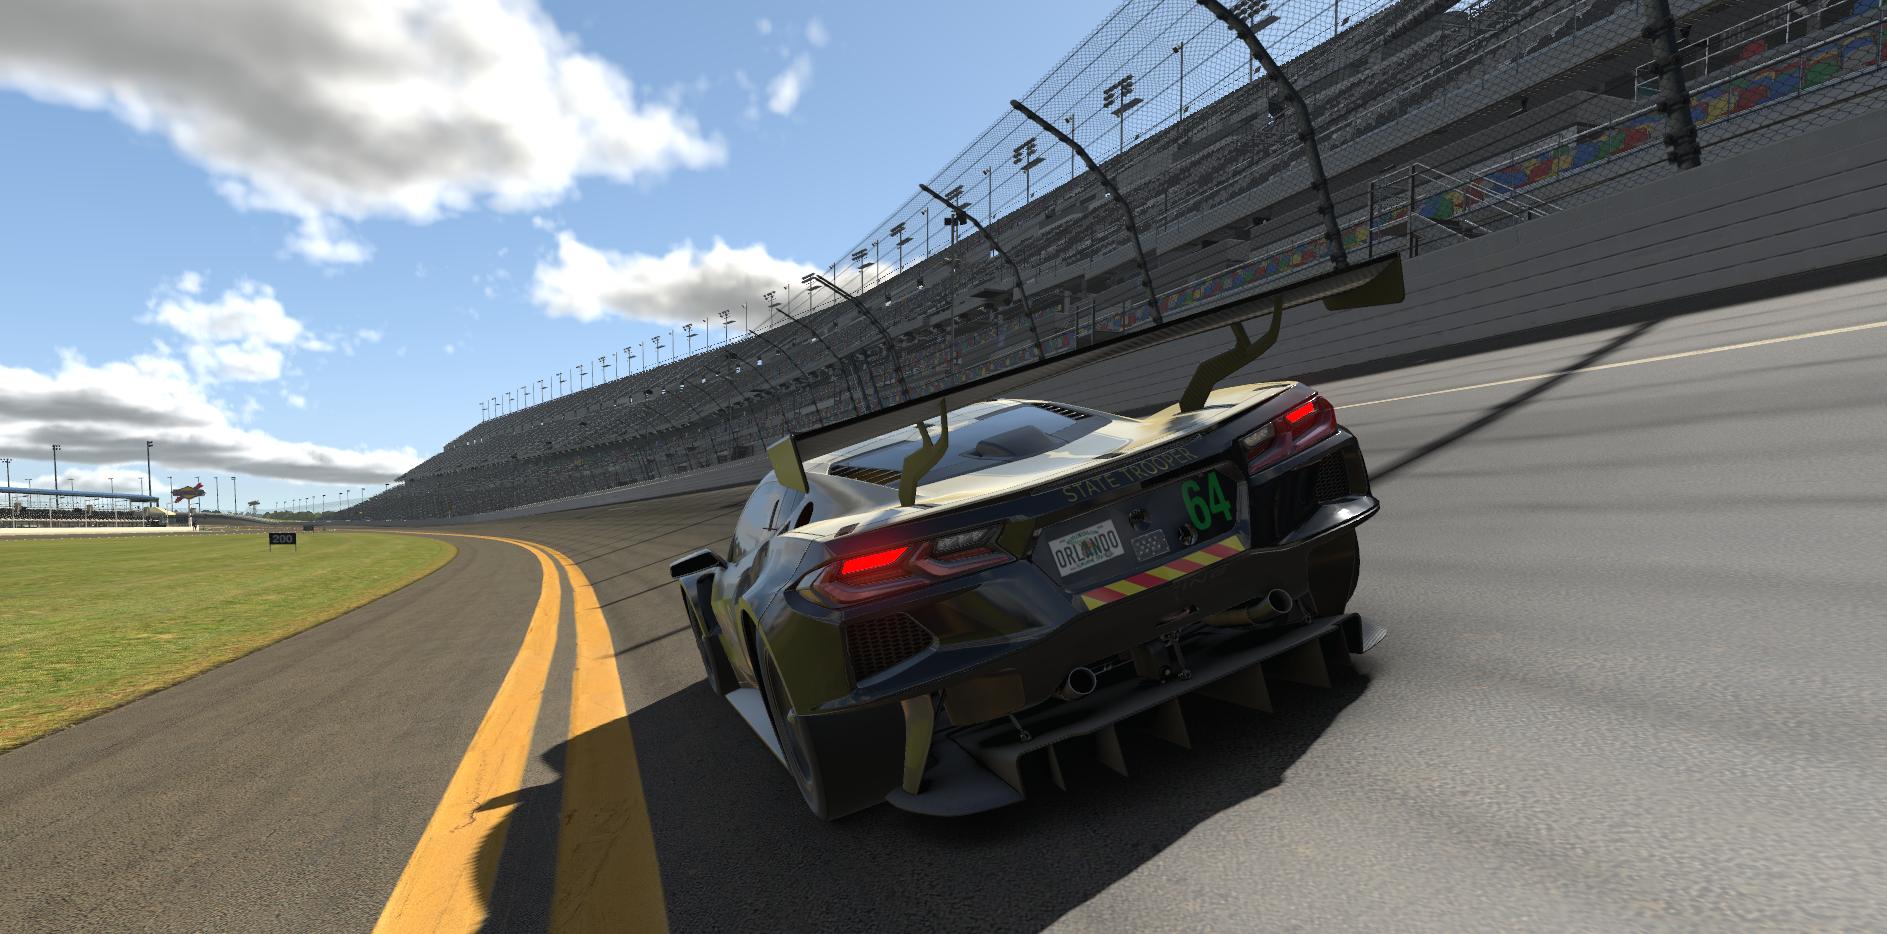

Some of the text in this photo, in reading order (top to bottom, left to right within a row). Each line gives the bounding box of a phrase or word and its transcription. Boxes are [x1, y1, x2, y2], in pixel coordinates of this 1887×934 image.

[1063, 447, 1199, 502] STATE TROOPER
[1182, 471, 1232, 530] 64
[272, 535, 293, 544] 200
[1055, 530, 1119, 569] ORLANDO
